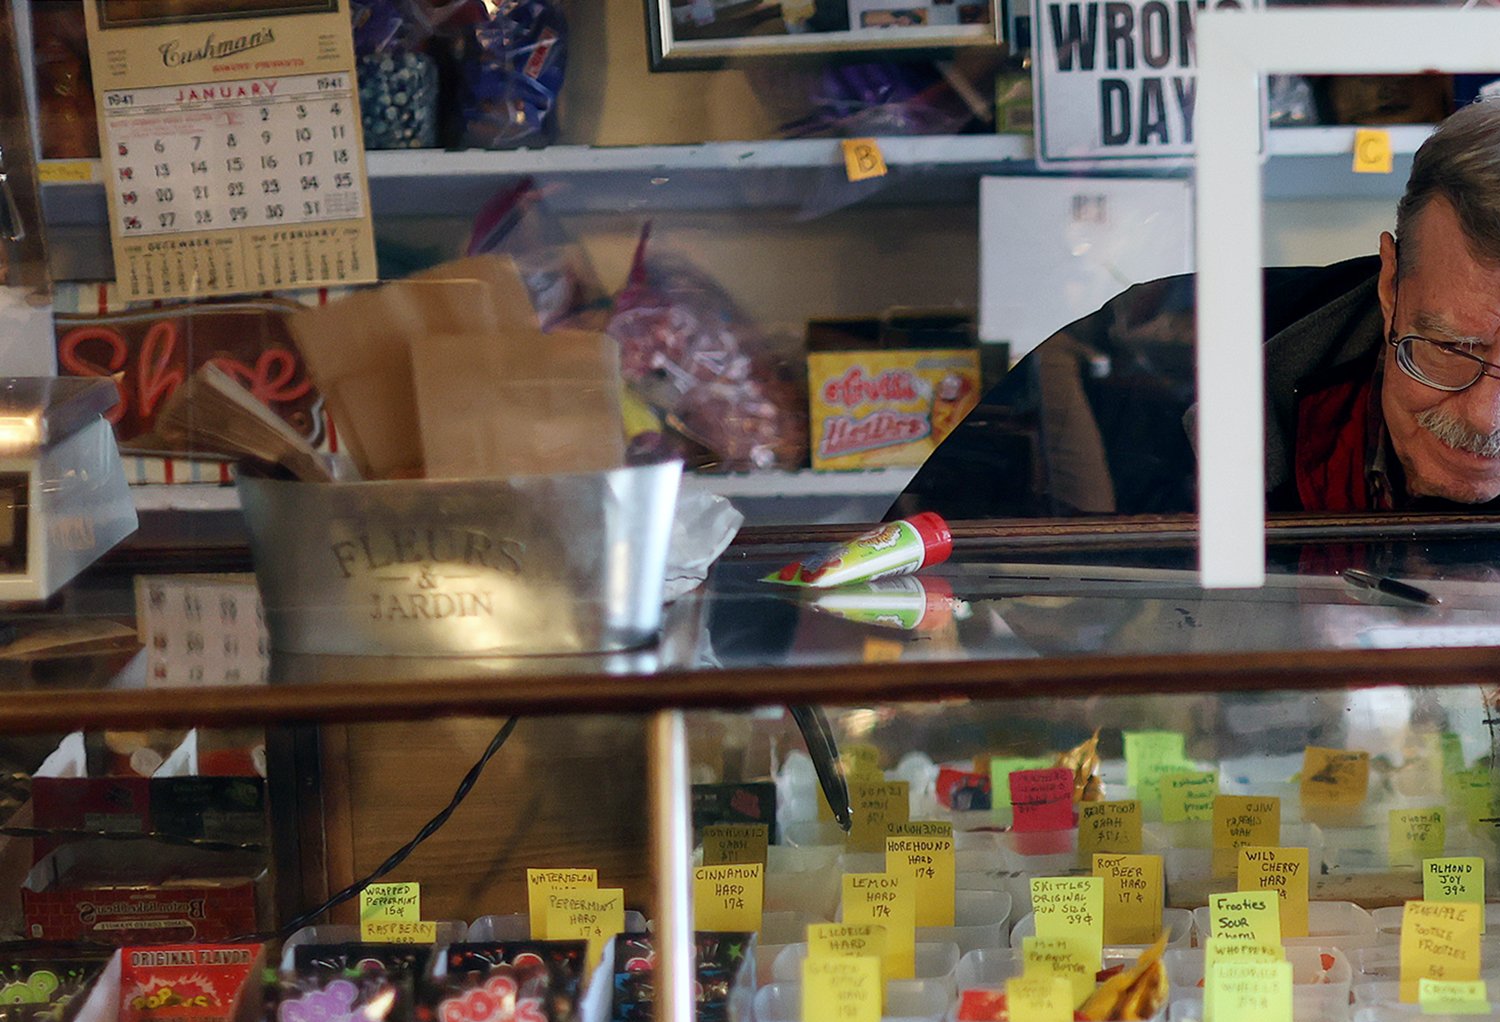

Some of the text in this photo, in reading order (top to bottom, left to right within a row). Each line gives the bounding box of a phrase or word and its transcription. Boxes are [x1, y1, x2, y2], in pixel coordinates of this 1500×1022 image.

[158, 27, 275, 68] Cushman's
[176, 79, 279, 104] JANUARY
[330, 101, 342, 116] 4
[1100, 76, 1197, 146] DAY
[154, 139, 165, 153] 6
[193, 136, 202, 150] 7
[227, 133, 238, 148] 8
[261, 130, 271, 145] 9
[296, 127, 312, 142] 10
[332, 126, 346, 141] 11
[1360, 137, 1382, 165] C
[154, 164, 171, 178] 13
[191, 160, 208, 174] 14
[226, 157, 244, 173] 15
[261, 155, 278, 169] 16
[299, 151, 314, 166] 17
[333, 150, 348, 165] 18
[155, 187, 174, 203] 20
[193, 185, 209, 200] 21
[227, 182, 245, 197] 22
[261, 179, 281, 194] 23
[300, 176, 320, 191] 24
[334, 172, 353, 188] 25
[158, 212, 176, 227] 27
[330, 526, 526, 579] FLEURS
[416, 562, 438, 589] &
[370, 591, 494, 620] JARDIN
[887, 840, 951, 852] HOREHOUND
[908, 854, 933, 865] HARD
[1097, 856, 1127, 869] ROOT
[1245, 851, 1276, 862] WILD
[695, 866, 759, 880] CINNAMON
[915, 866, 936, 879] 17¢
[1112, 867, 1143, 878] BEER
[1261, 862, 1300, 876] CHERRY
[1430, 863, 1473, 874] ALMOND
[530, 872, 595, 885] WATERMELON
[852, 877, 900, 889] LEMON
[1121, 879, 1147, 889] HARD
[1259, 875, 1287, 888] HARD
[1440, 874, 1462, 884] JOY
[364, 885, 411, 897] WRAPPED
[715, 884, 745, 896] HARD
[1033, 881, 1092, 892] SKITTLES
[366, 895, 418, 907] PEPPERMINT
[866, 890, 897, 902] HARD
[1033, 893, 1087, 904] ORIGINAL
[549, 894, 618, 912] PEPPERMINT
[724, 897, 745, 910] 17¢
[1034, 904, 1056, 914] FUN
[1217, 898, 1267, 911] Frooties
[872, 905, 892, 918] 17¢
[570, 914, 598, 925] HARD
[1066, 913, 1094, 926] 39¢
[367, 923, 434, 936] RASPBERRY
[830, 940, 866, 951] HARD
[131, 949, 251, 968] ORIGINAL FLAVOR
